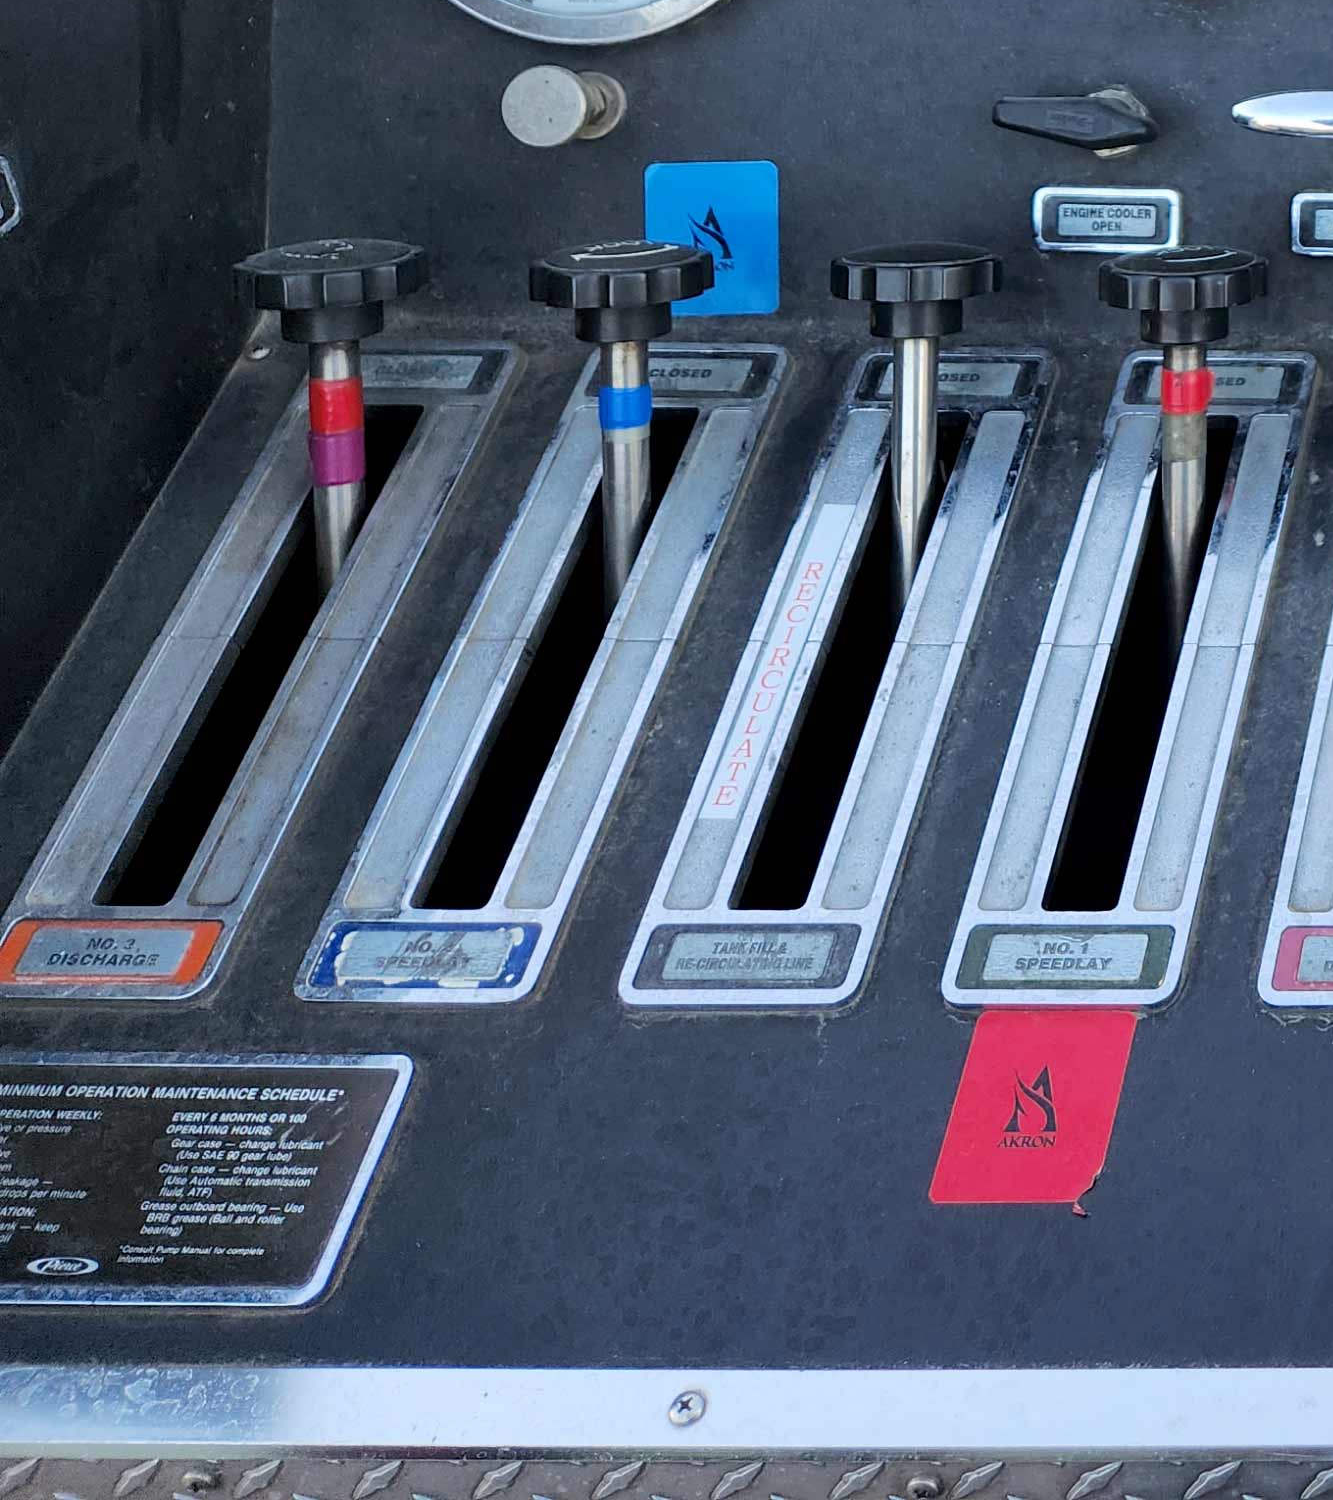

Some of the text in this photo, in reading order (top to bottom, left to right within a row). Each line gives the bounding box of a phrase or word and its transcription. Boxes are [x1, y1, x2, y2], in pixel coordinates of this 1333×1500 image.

[1063, 208, 1151, 219] ENGINE COOLER
[1092, 221, 1122, 231] OPEN
[712, 562, 824, 807] RECIRCULATE
[86, 938, 118, 950] NO.
[1042, 942, 1088, 954] NO. 1
[47, 953, 160, 966] DISCHARGE
[1015, 957, 1112, 970] SPEEDLAY
[0, 1084, 63, 1097] MINIMUM
[66, 1085, 149, 1098] OPERATION
[152, 1087, 258, 1100] MAINTENANCE
[172, 1112, 208, 1122] EVERY
[220, 1113, 267, 1123] MONTHS
[270, 1113, 286, 1123] OR
[289, 1114, 307, 1124] 100
[166, 1125, 228, 1135] OPERATING
[997, 1136, 1056, 1148] AKRON
